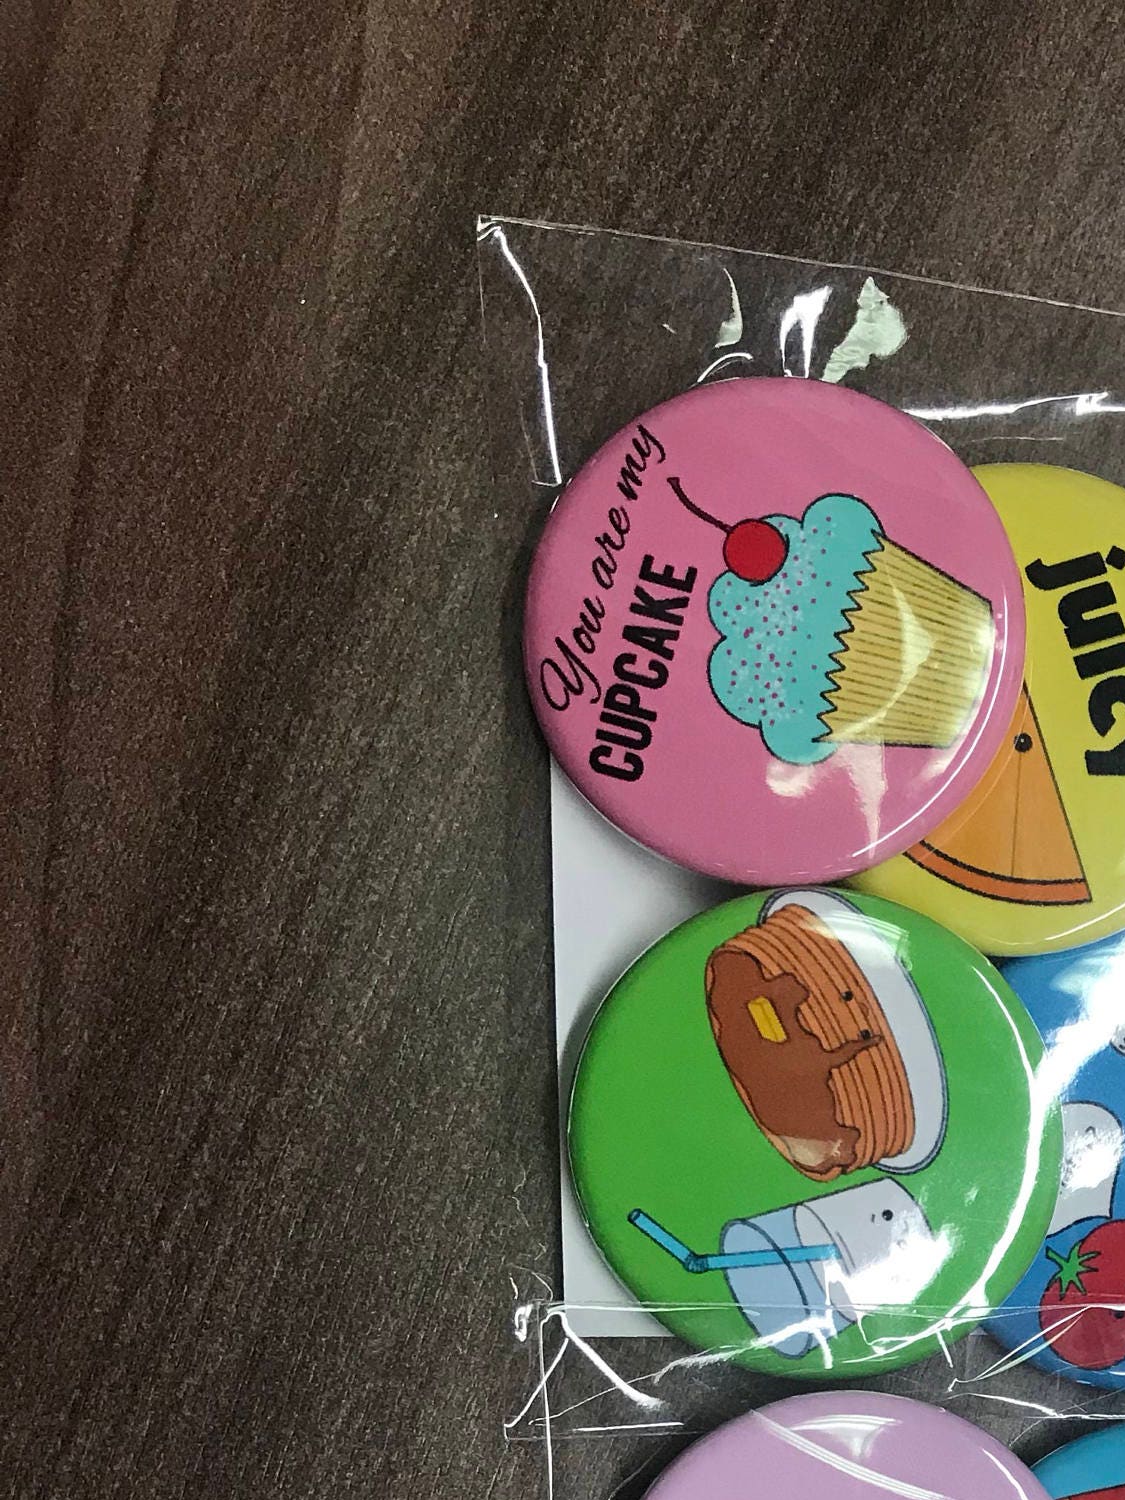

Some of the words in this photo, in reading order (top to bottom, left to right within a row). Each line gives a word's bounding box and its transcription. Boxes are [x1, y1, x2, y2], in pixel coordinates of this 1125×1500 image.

[540, 595, 606, 712] You
[592, 505, 631, 590] are
[616, 423, 667, 500] my
[588, 554, 698, 783] CUPCAKE
